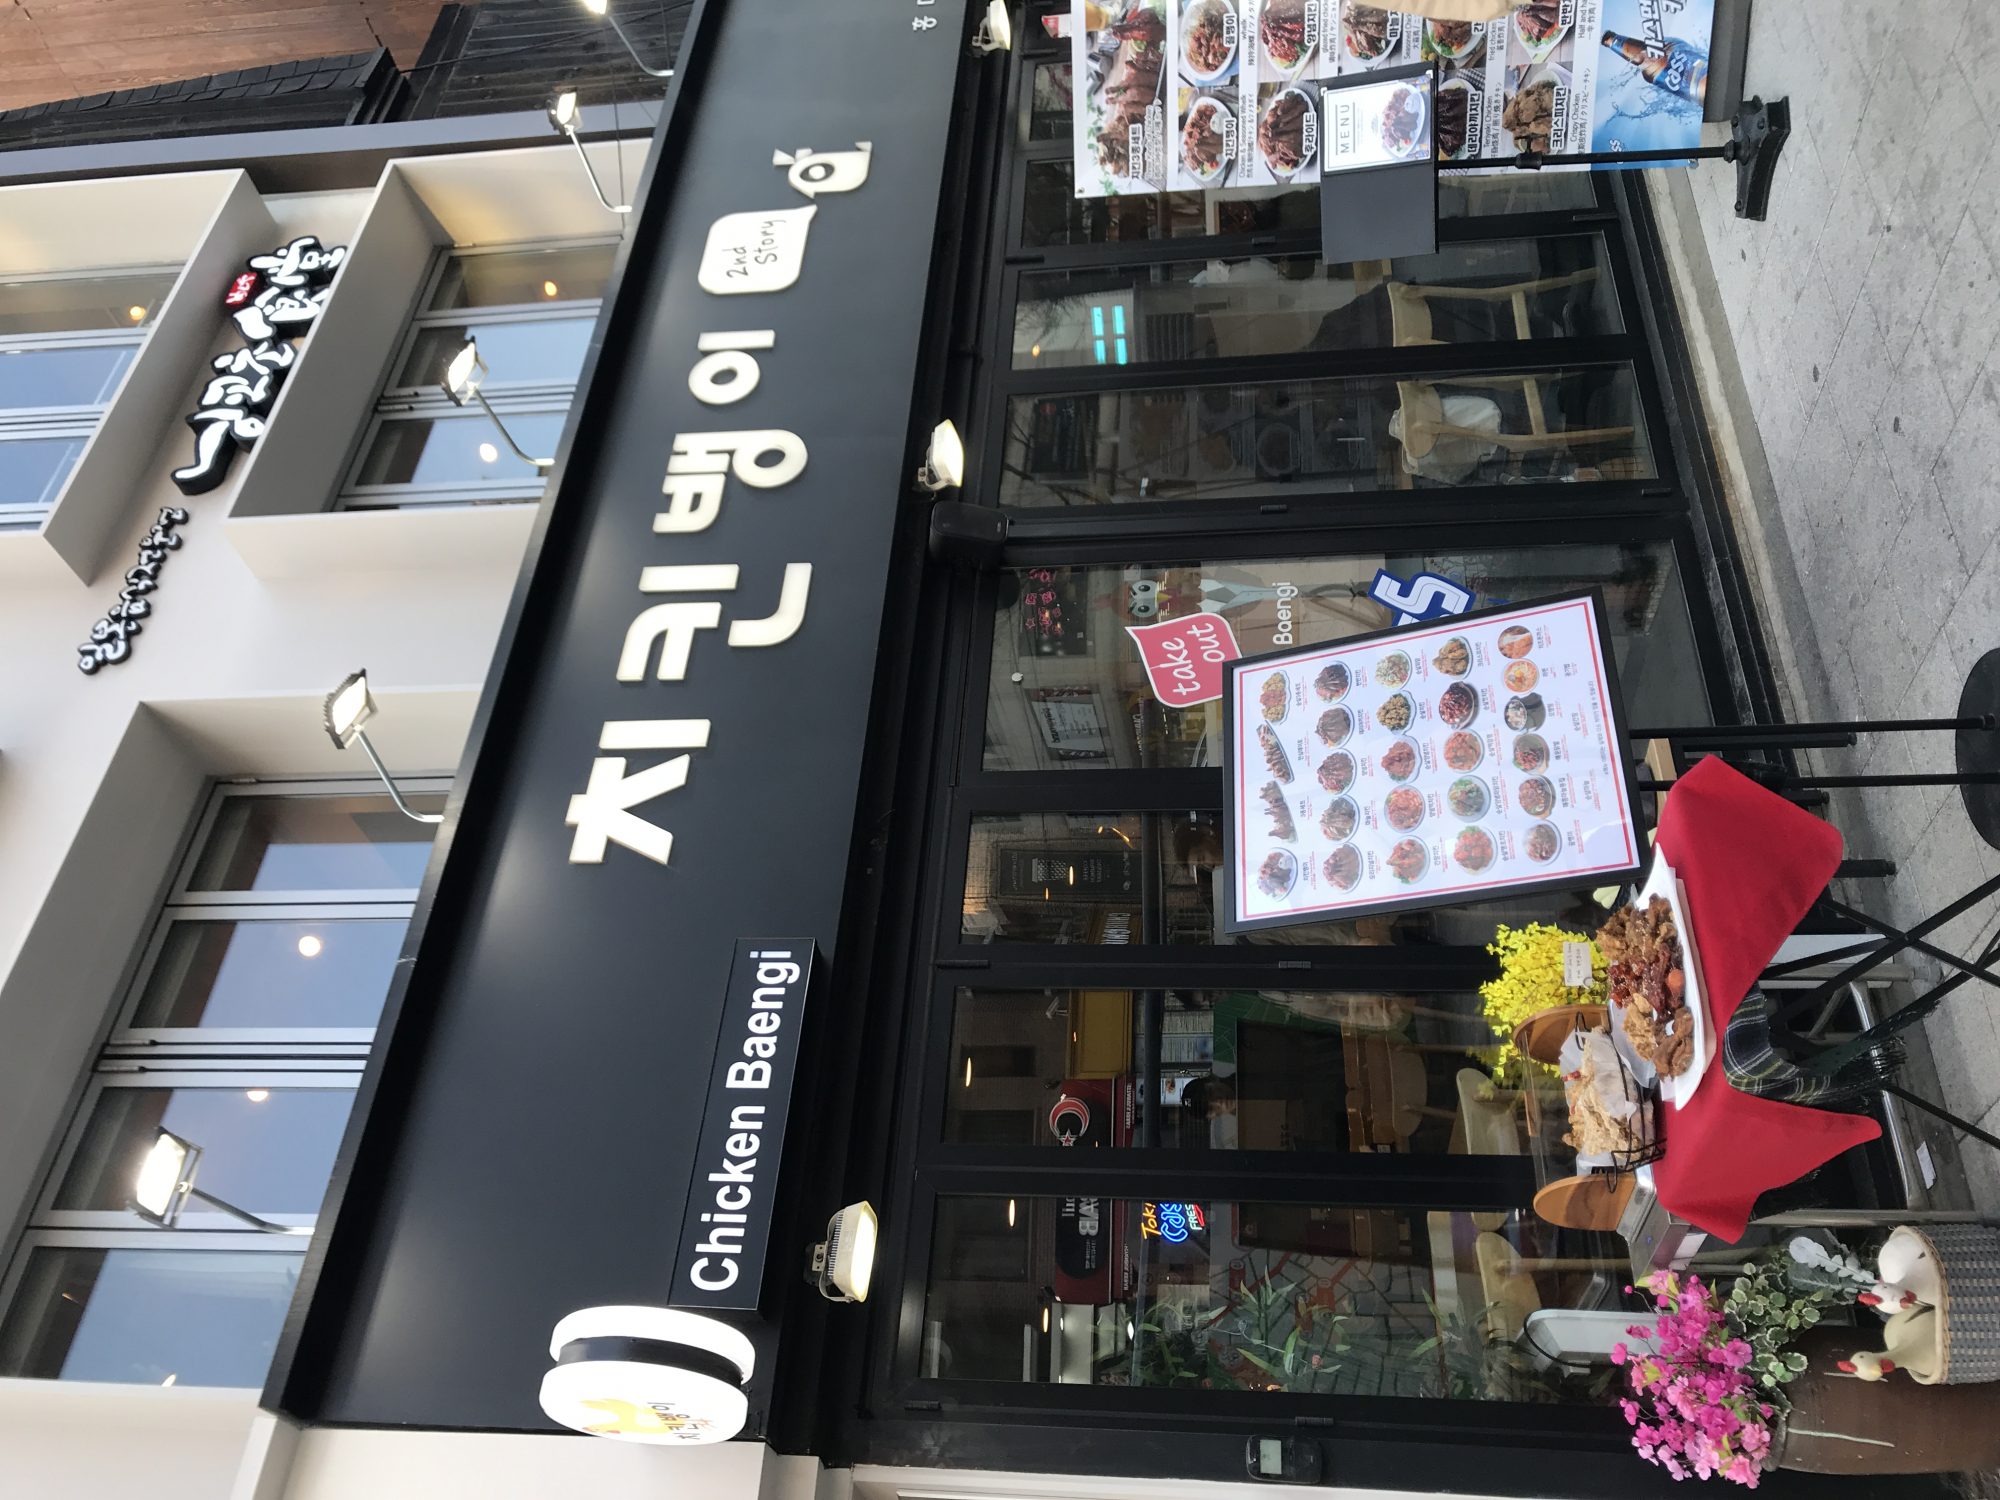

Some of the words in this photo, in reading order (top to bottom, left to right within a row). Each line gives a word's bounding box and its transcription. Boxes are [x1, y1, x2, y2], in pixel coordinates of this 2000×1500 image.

[1306, 3, 1317, 44] 양념치킨
[1577, 24, 1585, 39] Half
[1579, 9, 1587, 23] and
[1467, 93, 1480, 153] 데리야끼치킨
[1485, 95, 1493, 122] Chicken
[1552, 87, 1567, 148] 크리스피치킨
[1571, 93, 1581, 120] Chicken
[1339, 104, 1350, 154] MENU
[1483, 124, 1492, 148] Teriyaki
[1570, 121, 1579, 142] Crispy
[721, 246, 749, 278] 2nd
[754, 219, 787, 265] Story
[564, 330, 813, 864] 치킨뱅이
[1272, 581, 1299, 645] Baengi
[1186, 622, 1225, 662] out
[1156, 637, 1201, 696] take
[725, 950, 800, 1089] Baengi
[689, 1105, 766, 1291] Chicken
